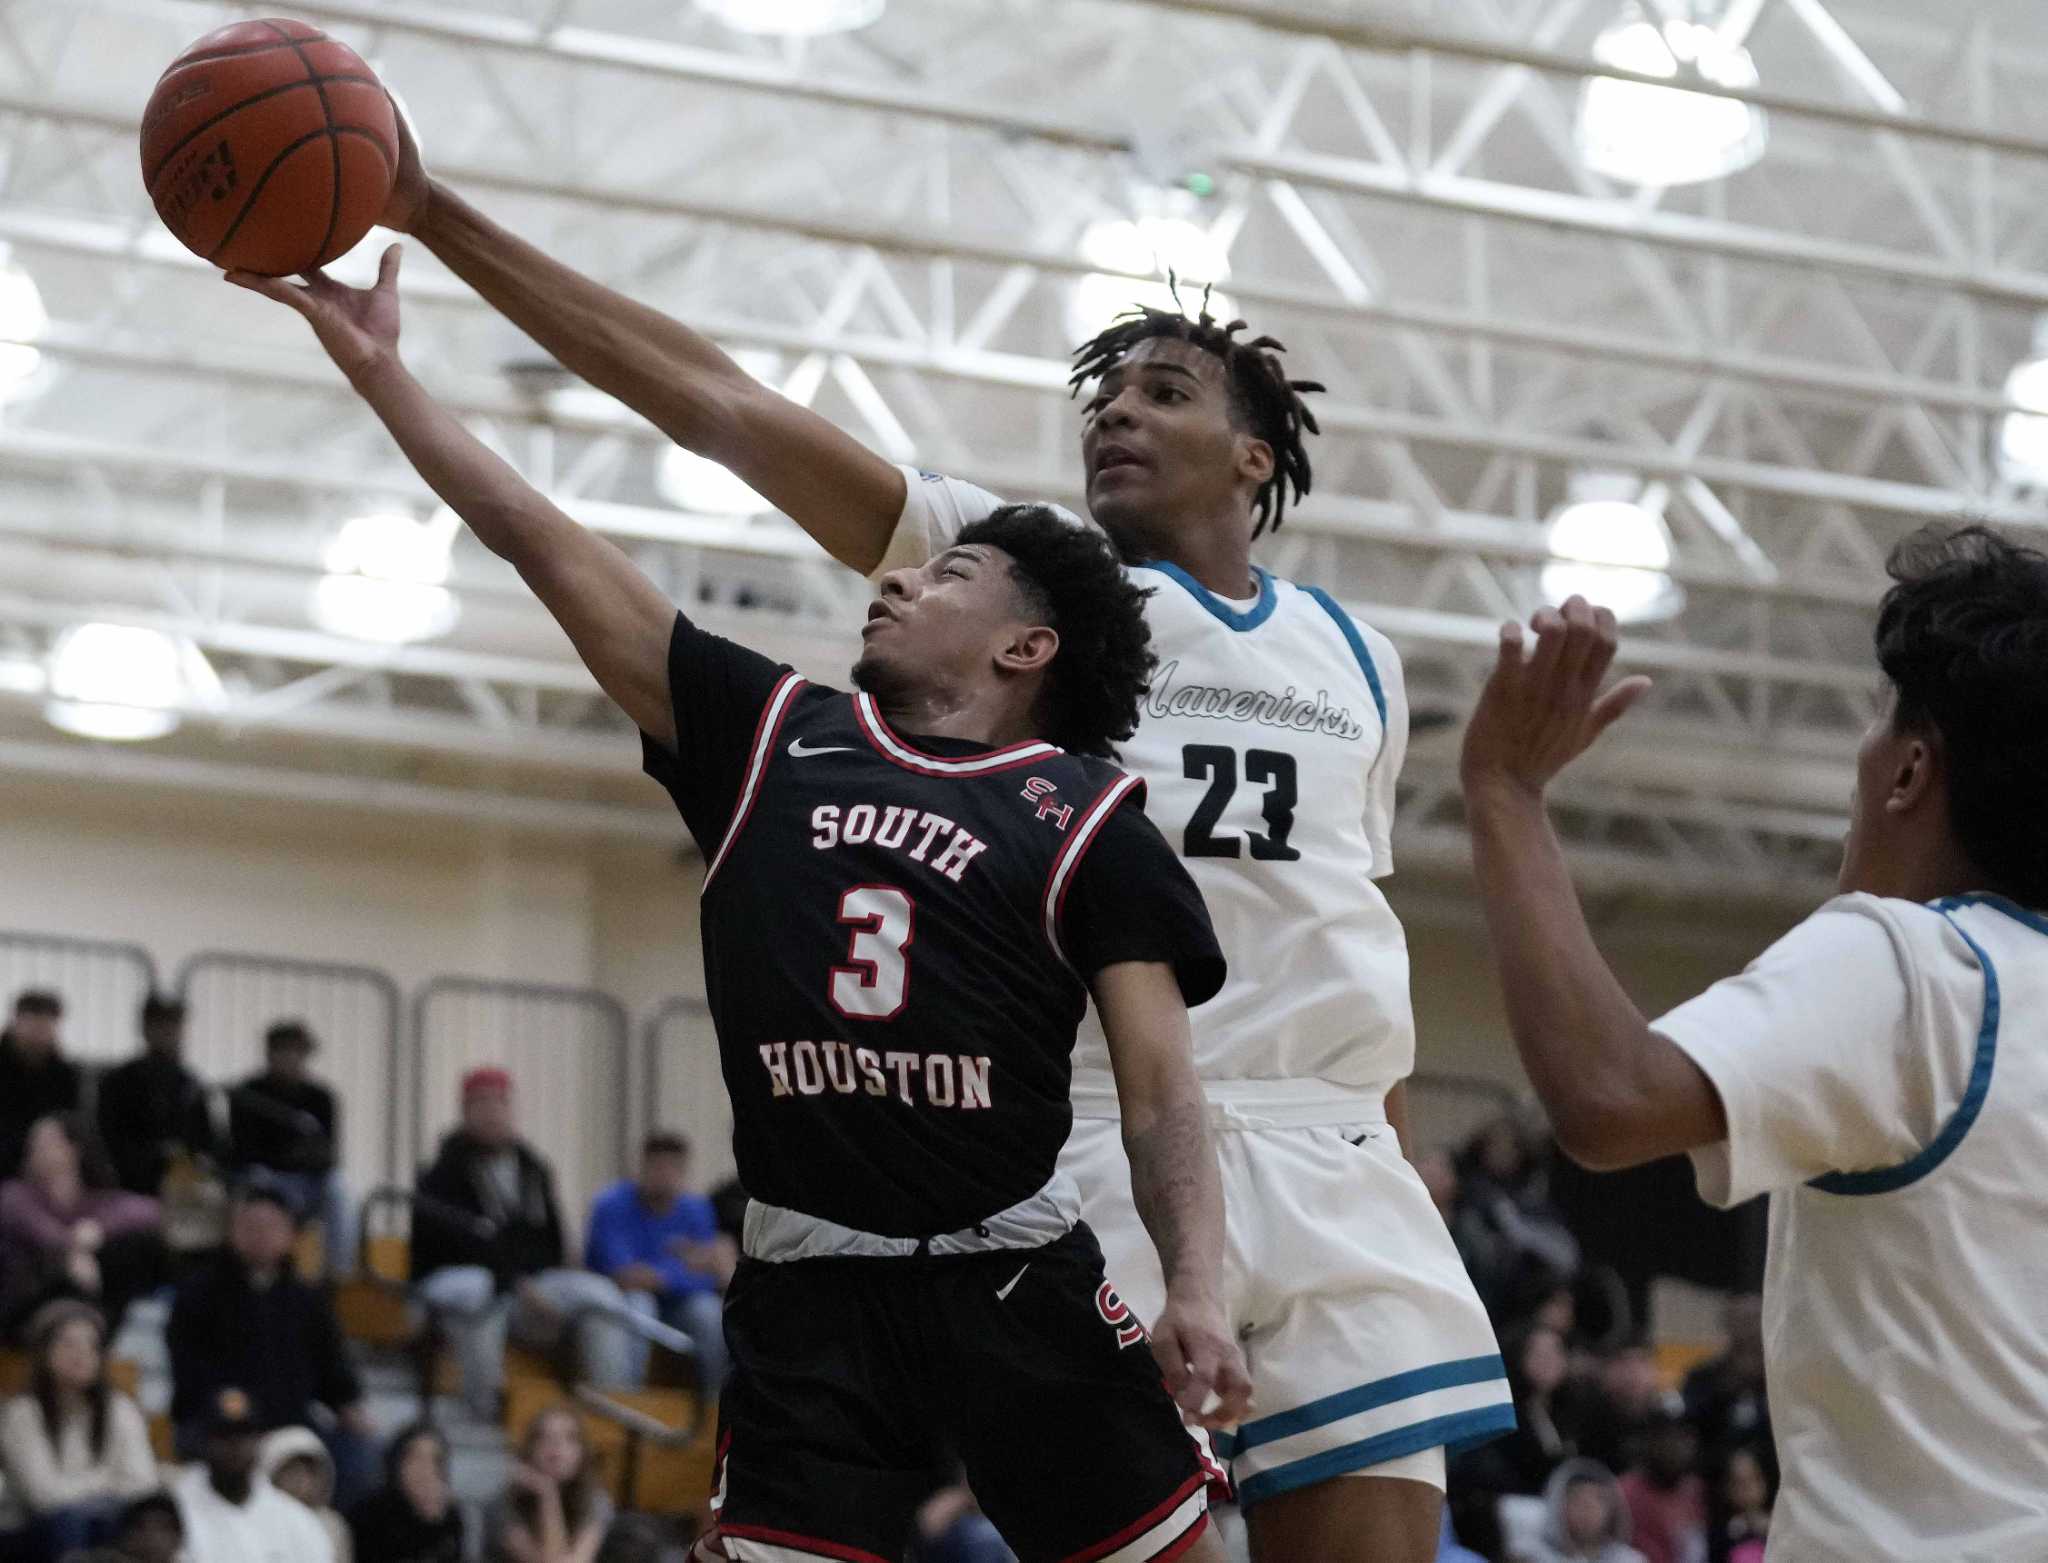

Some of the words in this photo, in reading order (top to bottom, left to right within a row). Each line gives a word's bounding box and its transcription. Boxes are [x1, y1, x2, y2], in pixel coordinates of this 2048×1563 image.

[810, 803, 989, 883] SOUTH
[1181, 743, 1301, 861] 23
[827, 883, 916, 1022] 3
[758, 1040, 993, 1110] HOUSTON
